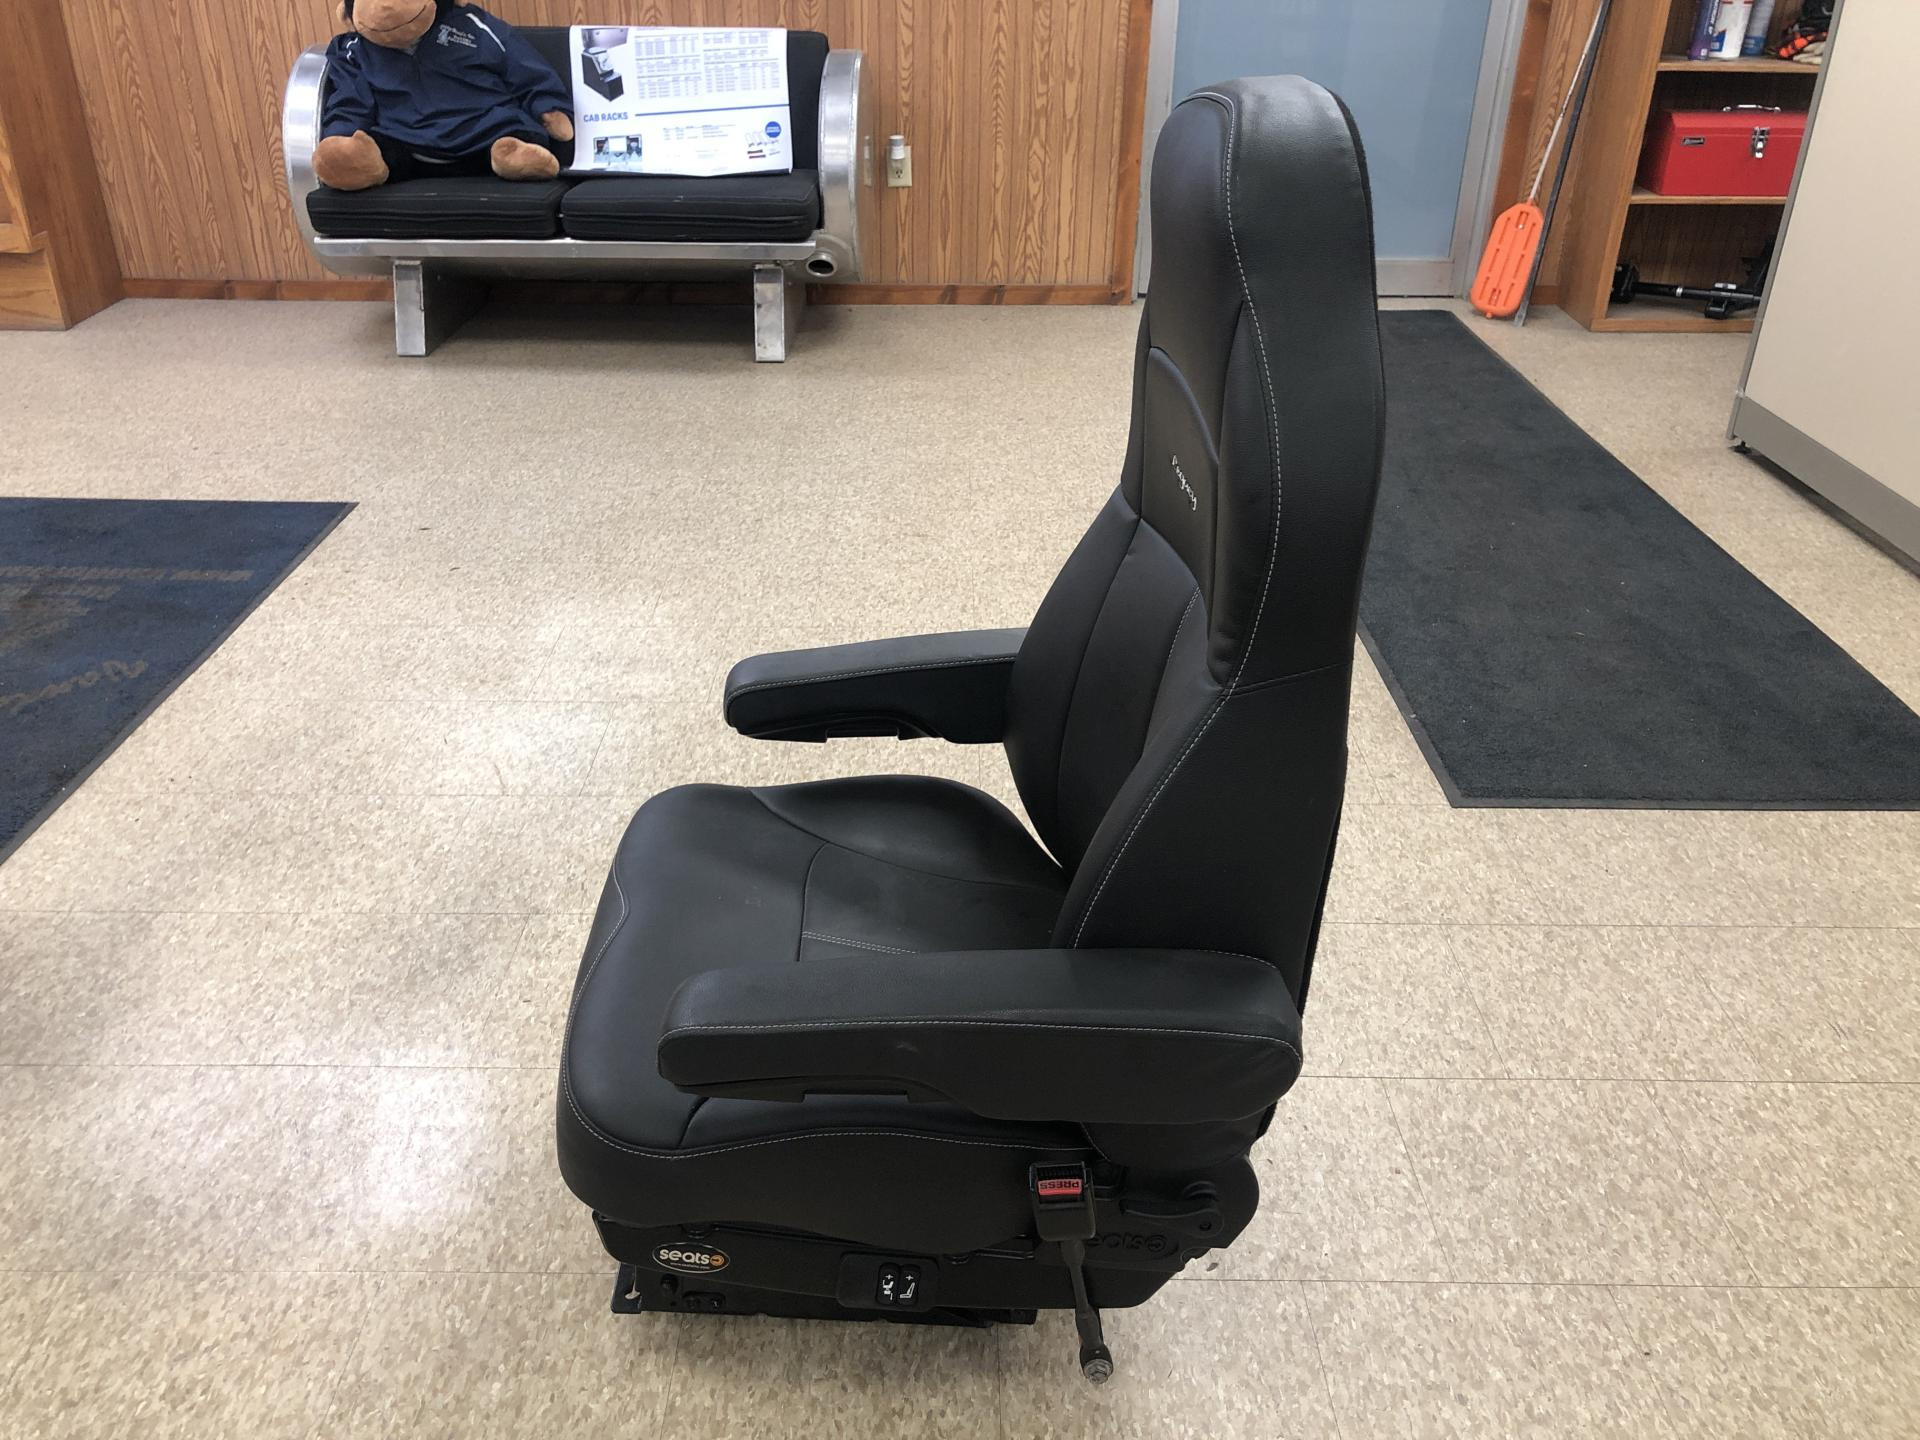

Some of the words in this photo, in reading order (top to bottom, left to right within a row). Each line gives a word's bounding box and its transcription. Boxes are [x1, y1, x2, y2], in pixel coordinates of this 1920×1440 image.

[583, 114, 599, 122] CAB
[601, 112, 628, 121] RACKS
[1040, 1181, 1080, 1190] PRESS
[659, 1249, 710, 1264] seats
